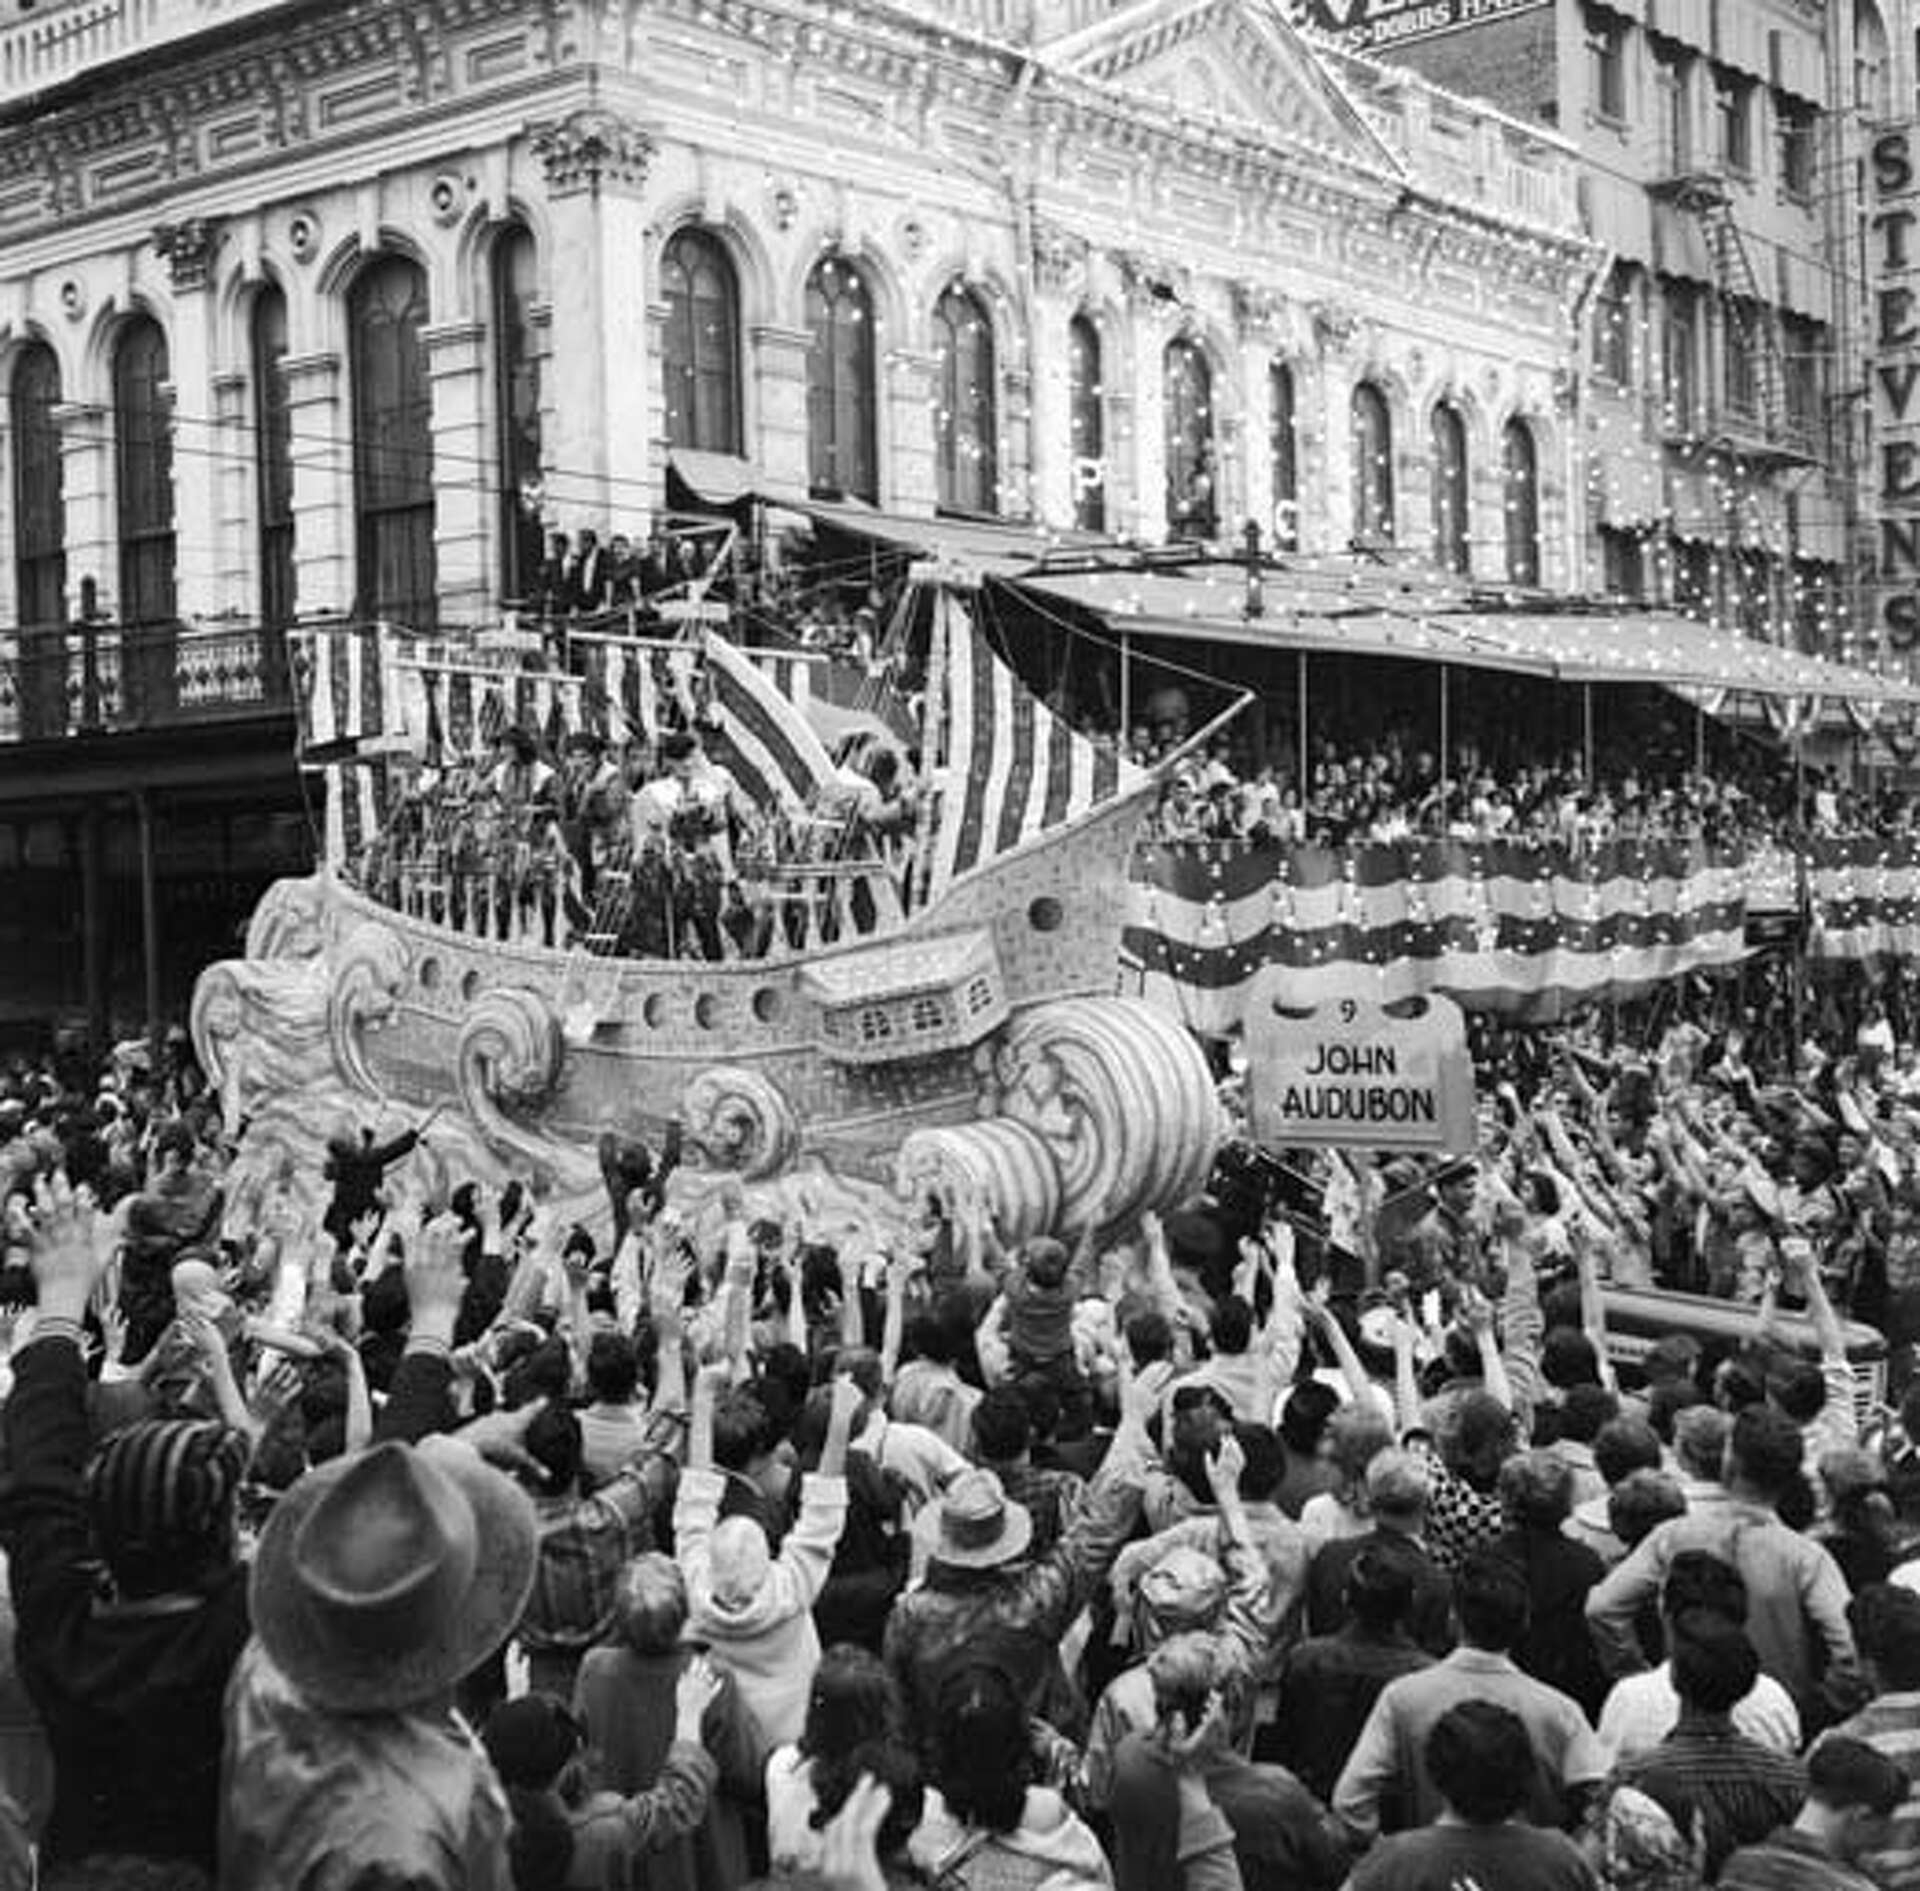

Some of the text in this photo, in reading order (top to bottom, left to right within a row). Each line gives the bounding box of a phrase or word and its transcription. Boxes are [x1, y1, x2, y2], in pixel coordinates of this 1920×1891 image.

[1872, 134, 1920, 649] STEVENS
[1340, 999, 1356, 1022] 9
[1306, 1044, 1396, 1075] JOHN
[1281, 1085, 1436, 1122] AUDUBON
